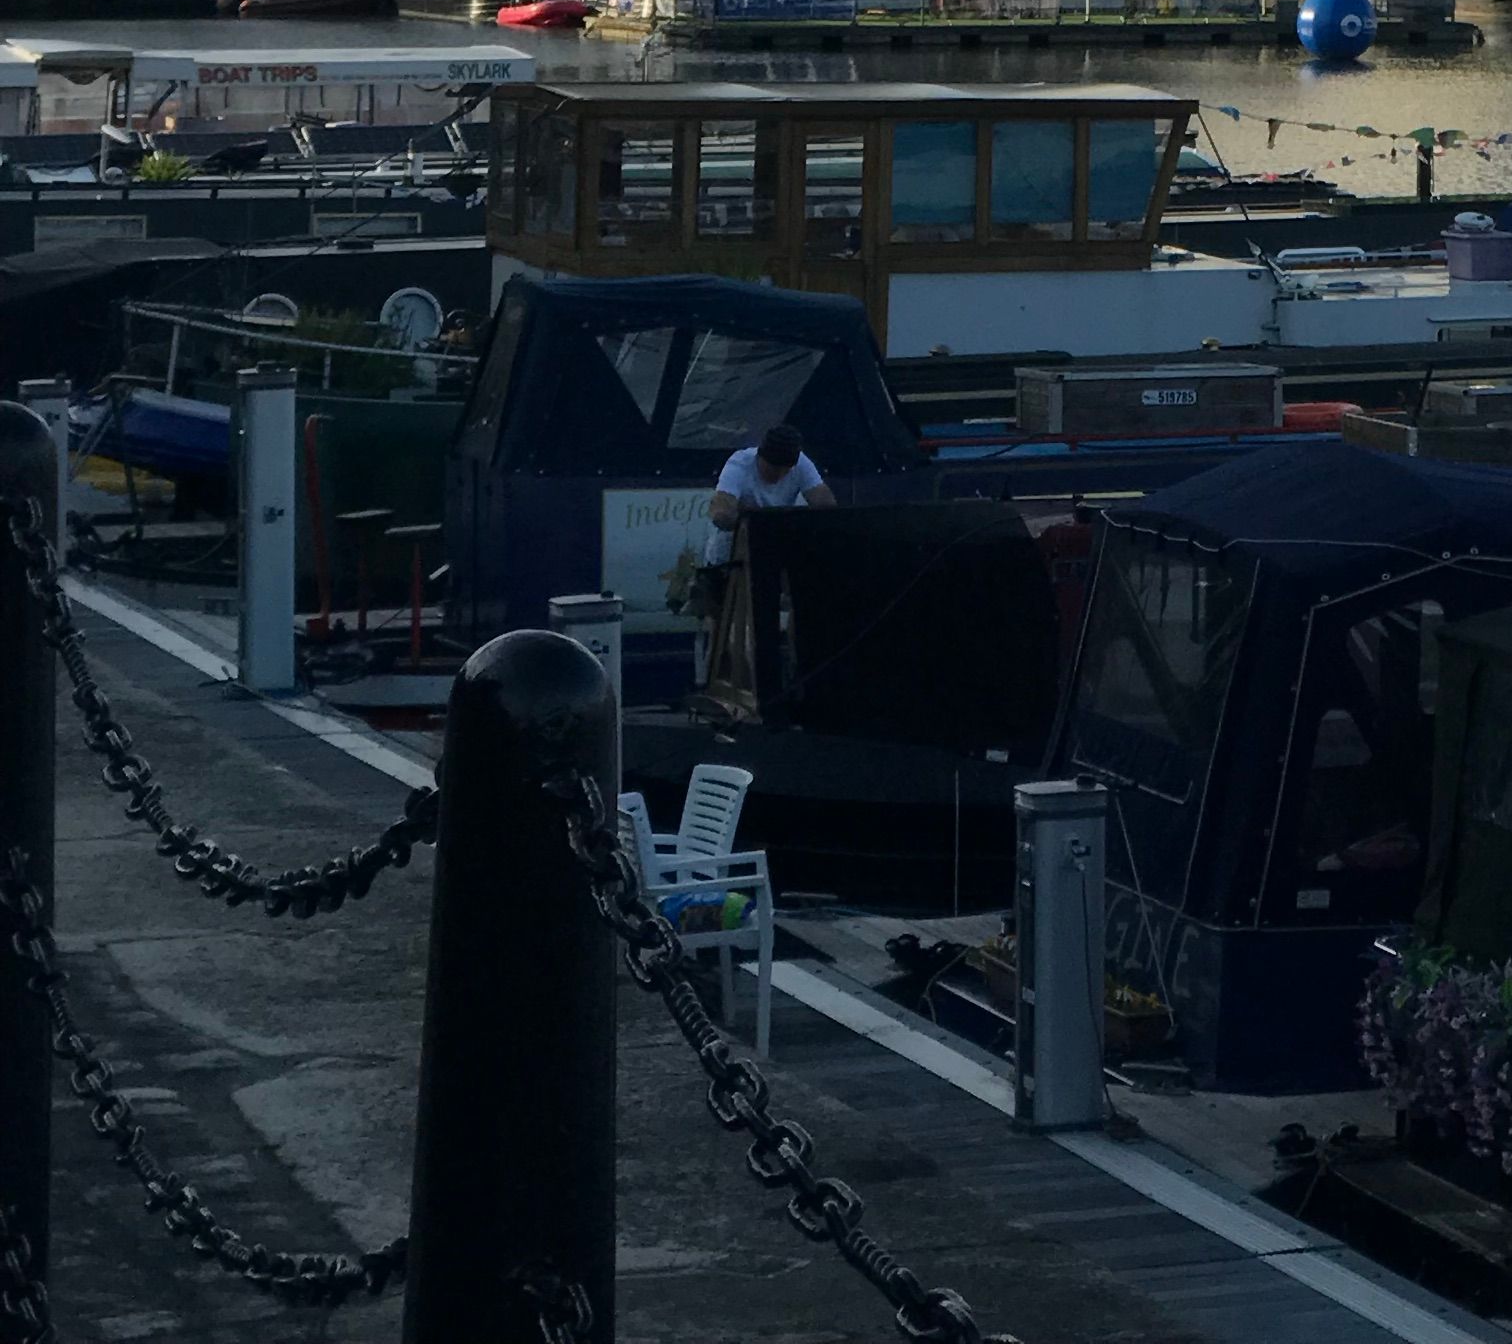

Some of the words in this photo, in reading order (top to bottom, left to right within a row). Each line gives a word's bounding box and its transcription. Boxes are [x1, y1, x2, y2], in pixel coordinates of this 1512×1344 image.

[198, 66, 252, 84] BOAT
[257, 65, 318, 83] TRIPS
[447, 62, 511, 79] SKYLARK
[1158, 391, 1194, 403] 519785
